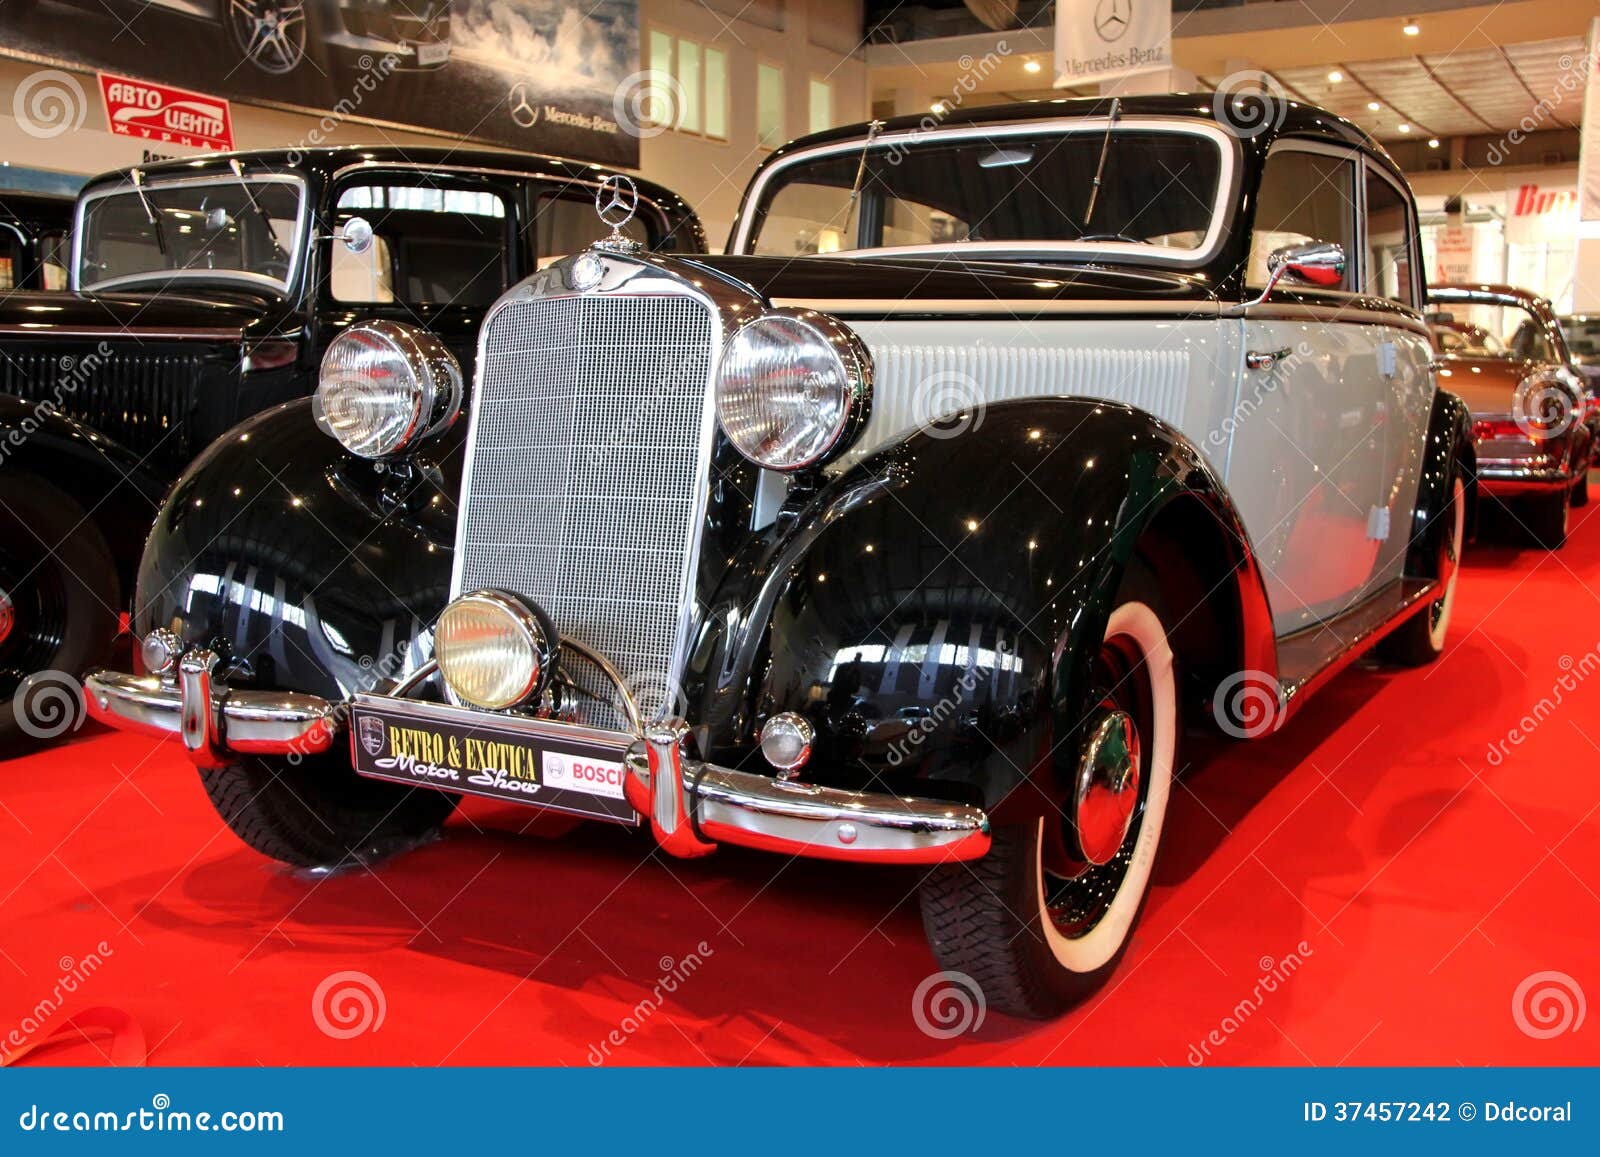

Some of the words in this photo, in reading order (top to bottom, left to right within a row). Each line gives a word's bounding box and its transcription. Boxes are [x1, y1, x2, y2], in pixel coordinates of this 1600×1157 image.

[1065, 46, 1164, 74] Mercedes-Benz
[108, 82, 162, 110] АВТО
[164, 108, 224, 137] ЦЕНТР
[544, 105, 618, 134] Mercedes-Benz
[389, 726, 444, 766] RETRO
[448, 735, 462, 769] &
[465, 738, 536, 781] EXOTICA
[375, 752, 460, 781] Motor
[467, 767, 541, 793] Show
